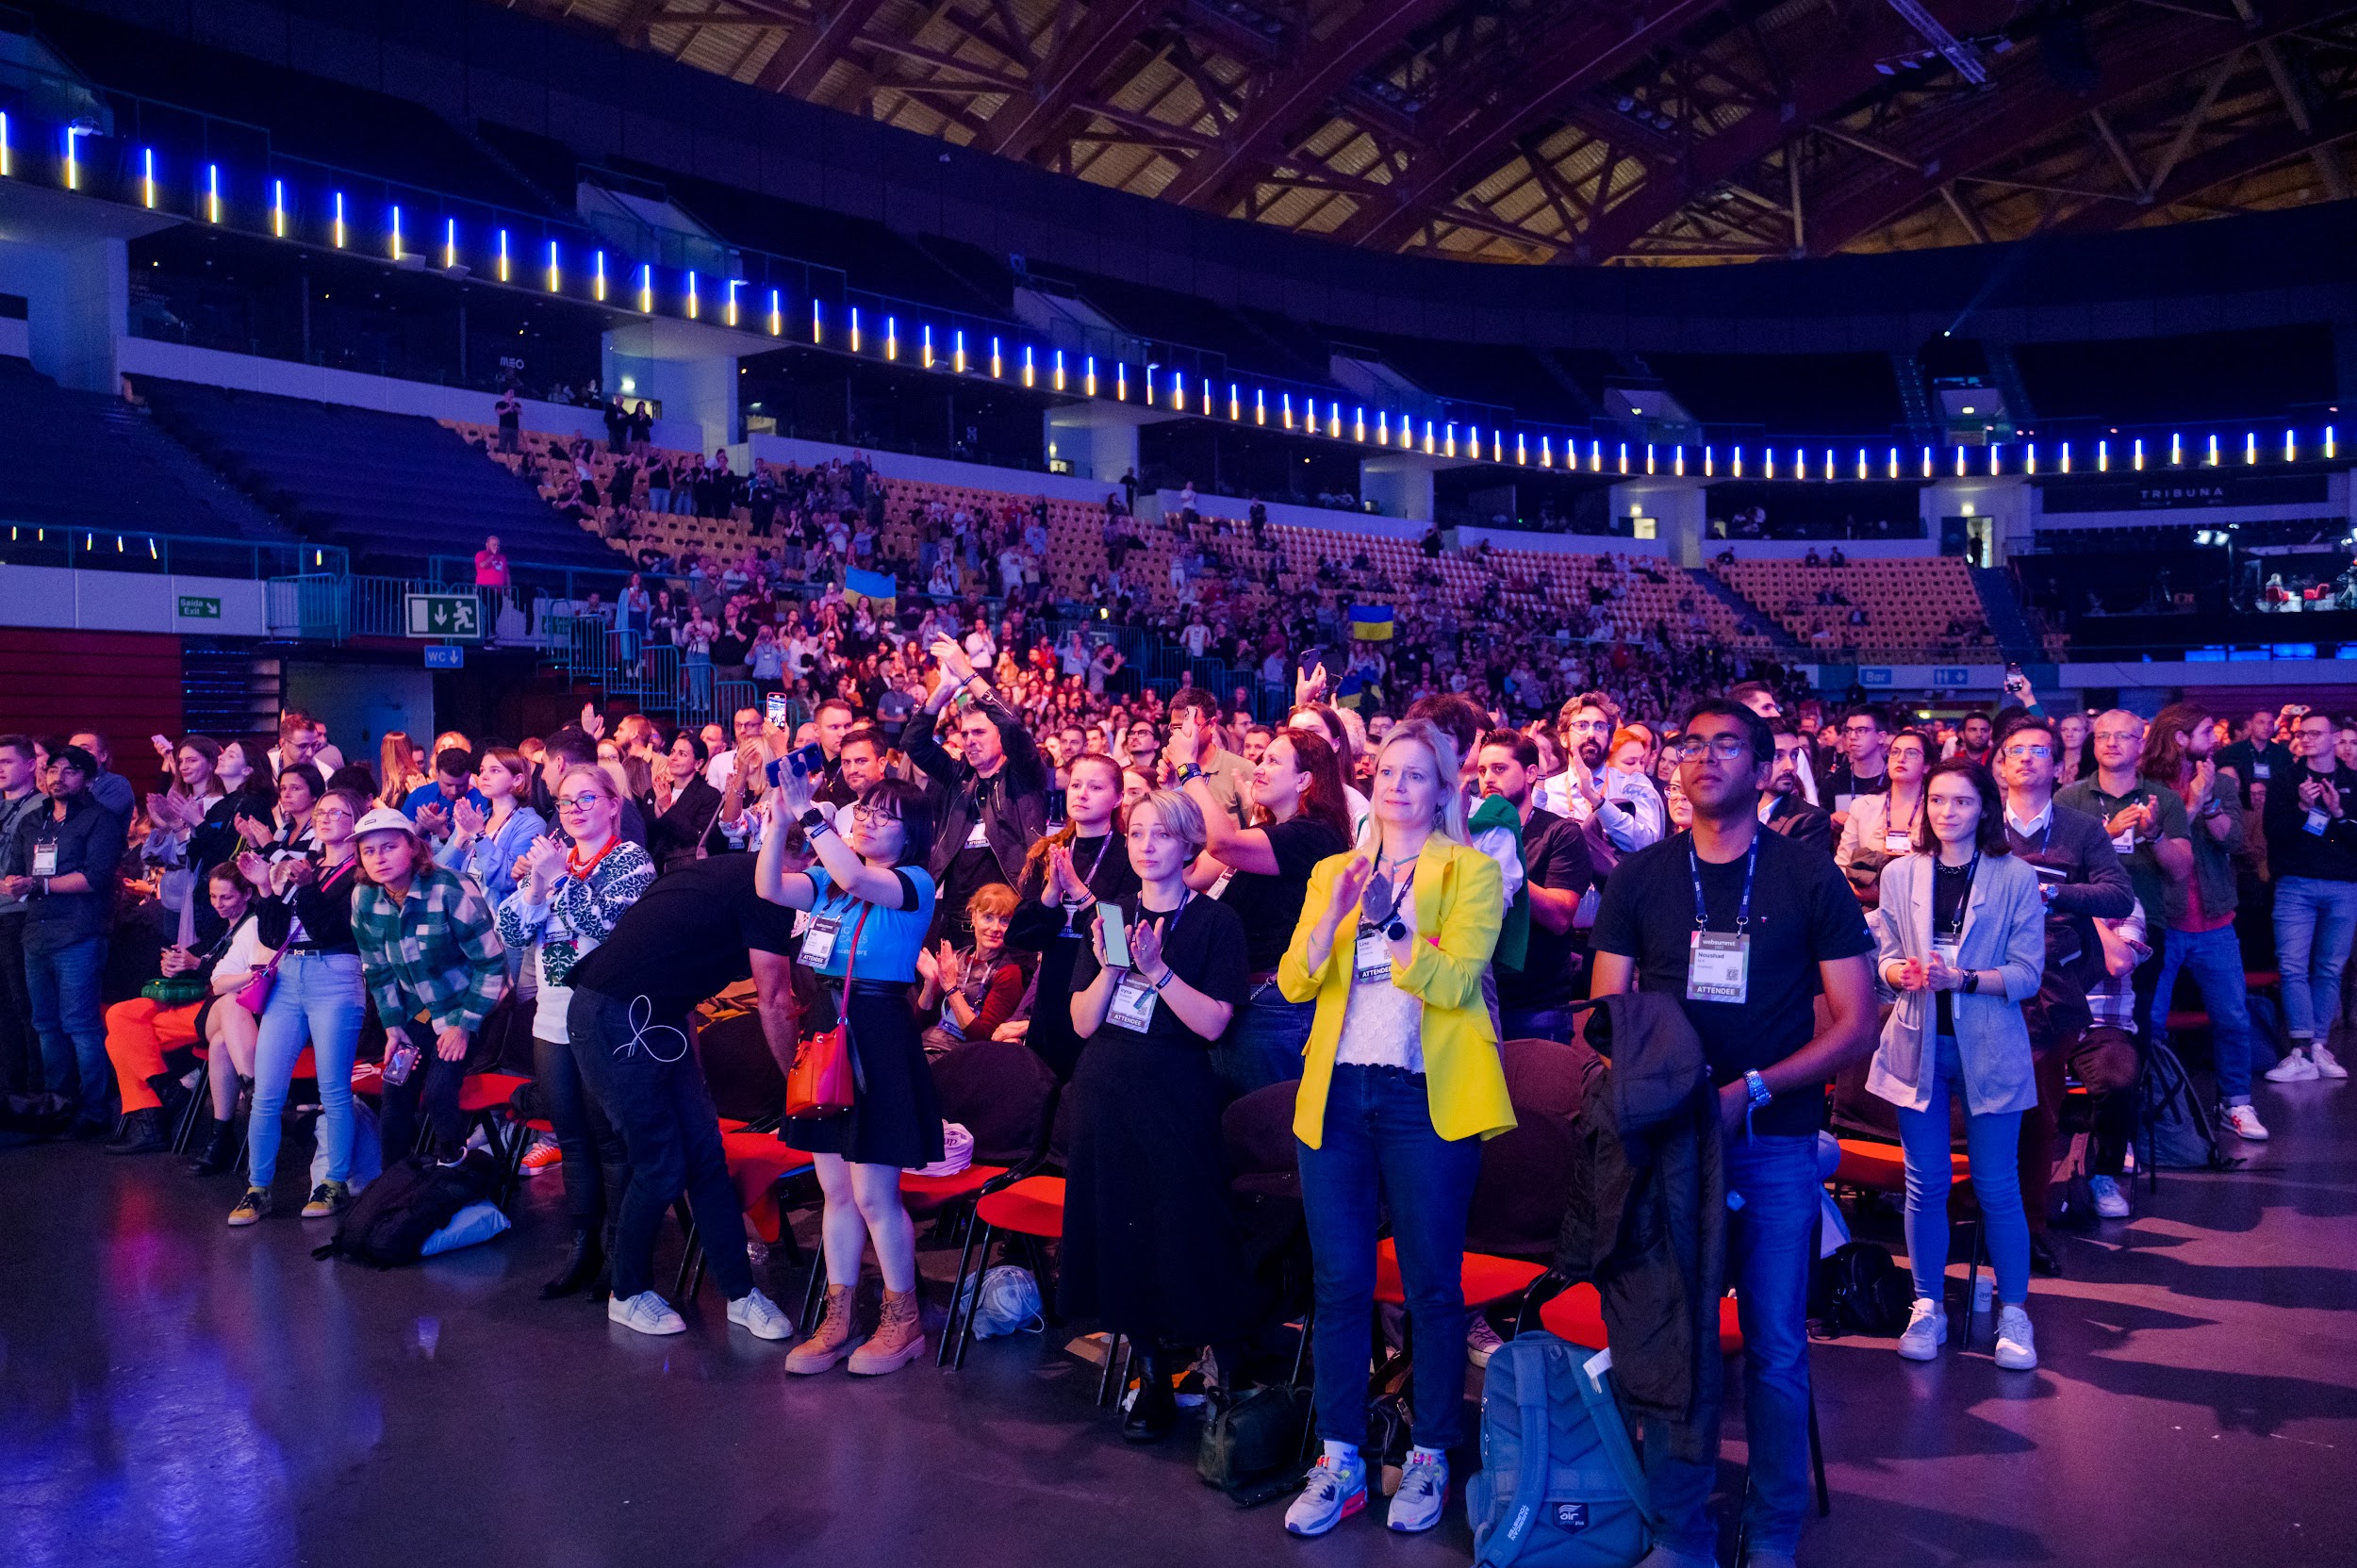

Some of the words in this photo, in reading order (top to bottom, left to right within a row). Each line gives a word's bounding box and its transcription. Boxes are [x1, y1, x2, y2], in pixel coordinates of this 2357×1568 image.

[500, 355, 524, 370] MEO
[2140, 487, 2223, 499] TRIBUNA
[184, 606, 199, 616] Exit
[428, 652, 446, 662] WC
[1867, 670, 1886, 682] Bar
[803, 954, 824, 964] ATTENDEE
[1362, 966, 1392, 978] ATTENDEE
[1697, 986, 1735, 995] ATTENDEE
[1114, 1014, 1142, 1027] ATTENDEE
[1559, 1511, 1579, 1520] air
[1510, 1506, 1529, 1541] AMERICAN
